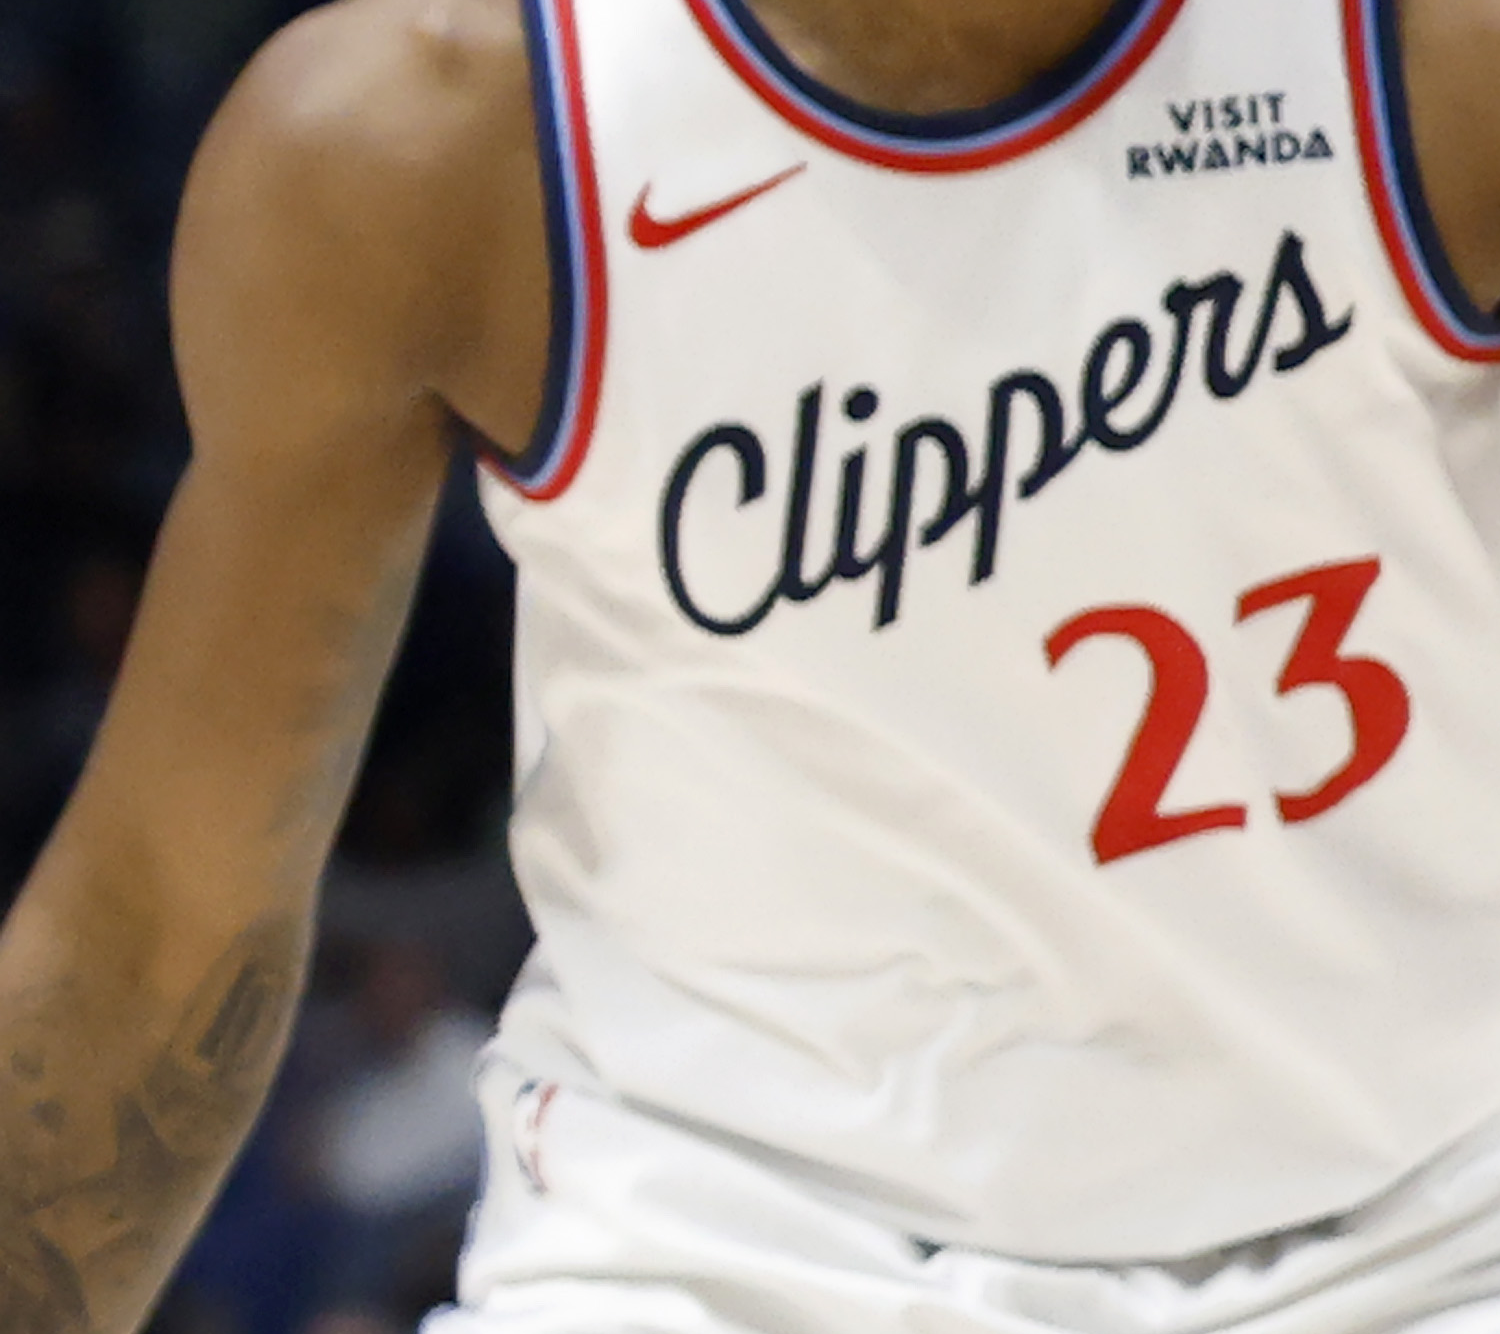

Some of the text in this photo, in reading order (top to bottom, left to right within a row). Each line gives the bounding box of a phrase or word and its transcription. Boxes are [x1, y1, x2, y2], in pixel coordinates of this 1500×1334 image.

[1126, 126, 1335, 180] RWANDA
[1167, 92, 1286, 133] VISIT
[657, 230, 1355, 636] Clippers
[1043, 555, 1411, 865] 23
